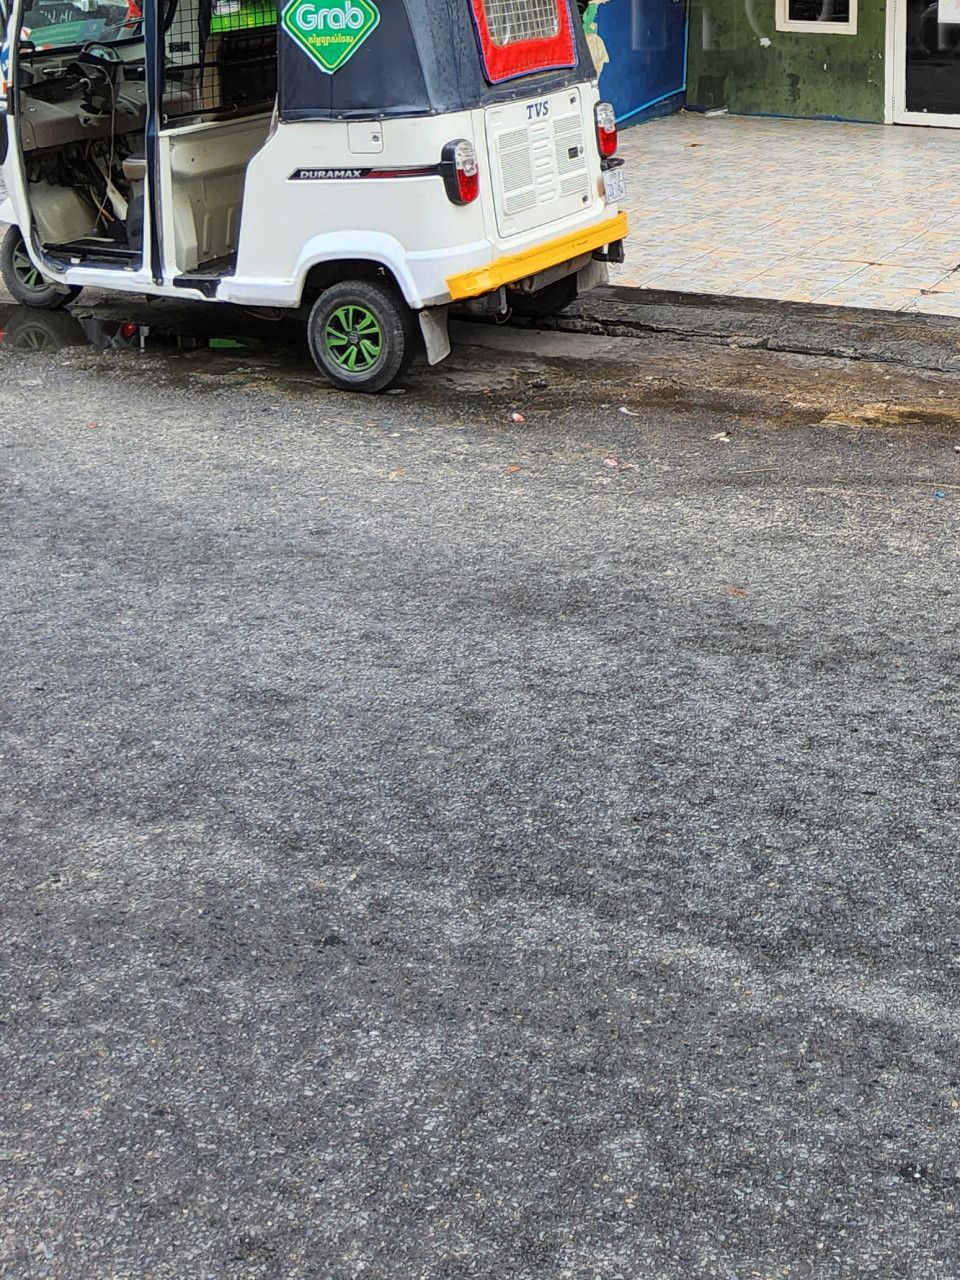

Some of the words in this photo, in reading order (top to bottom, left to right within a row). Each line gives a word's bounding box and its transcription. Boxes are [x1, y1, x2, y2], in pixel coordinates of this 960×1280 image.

[296, 0, 364, 30] Grab
[526, 101, 549, 120] TVS
[300, 169, 361, 179] DURAMAX
